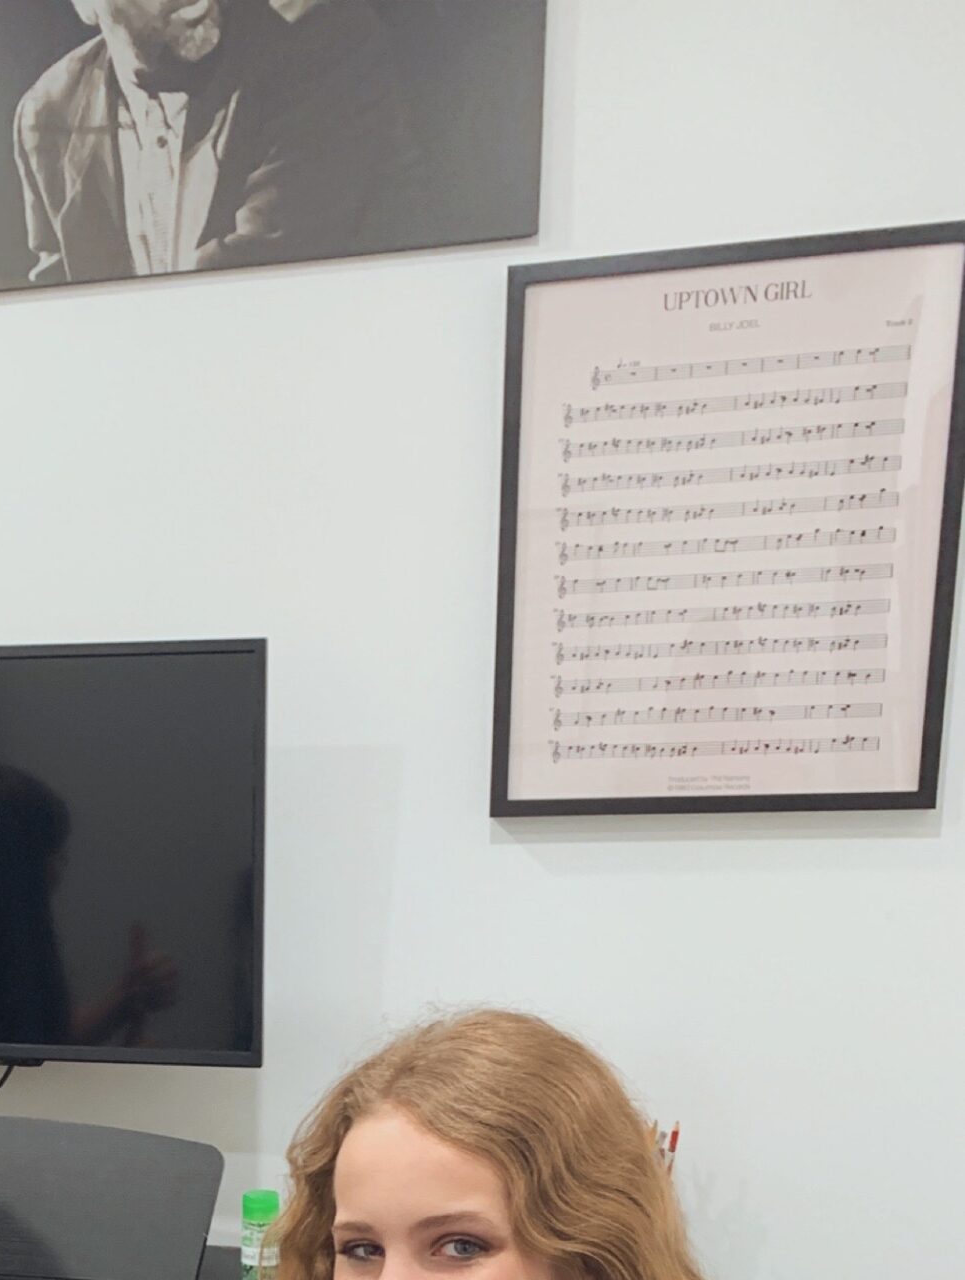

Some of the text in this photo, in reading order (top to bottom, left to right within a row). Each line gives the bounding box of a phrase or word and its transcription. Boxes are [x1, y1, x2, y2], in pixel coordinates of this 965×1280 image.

[663, 280, 813, 312] UPTOWN GIRL
[708, 318, 761, 332] BILLY JOEL
